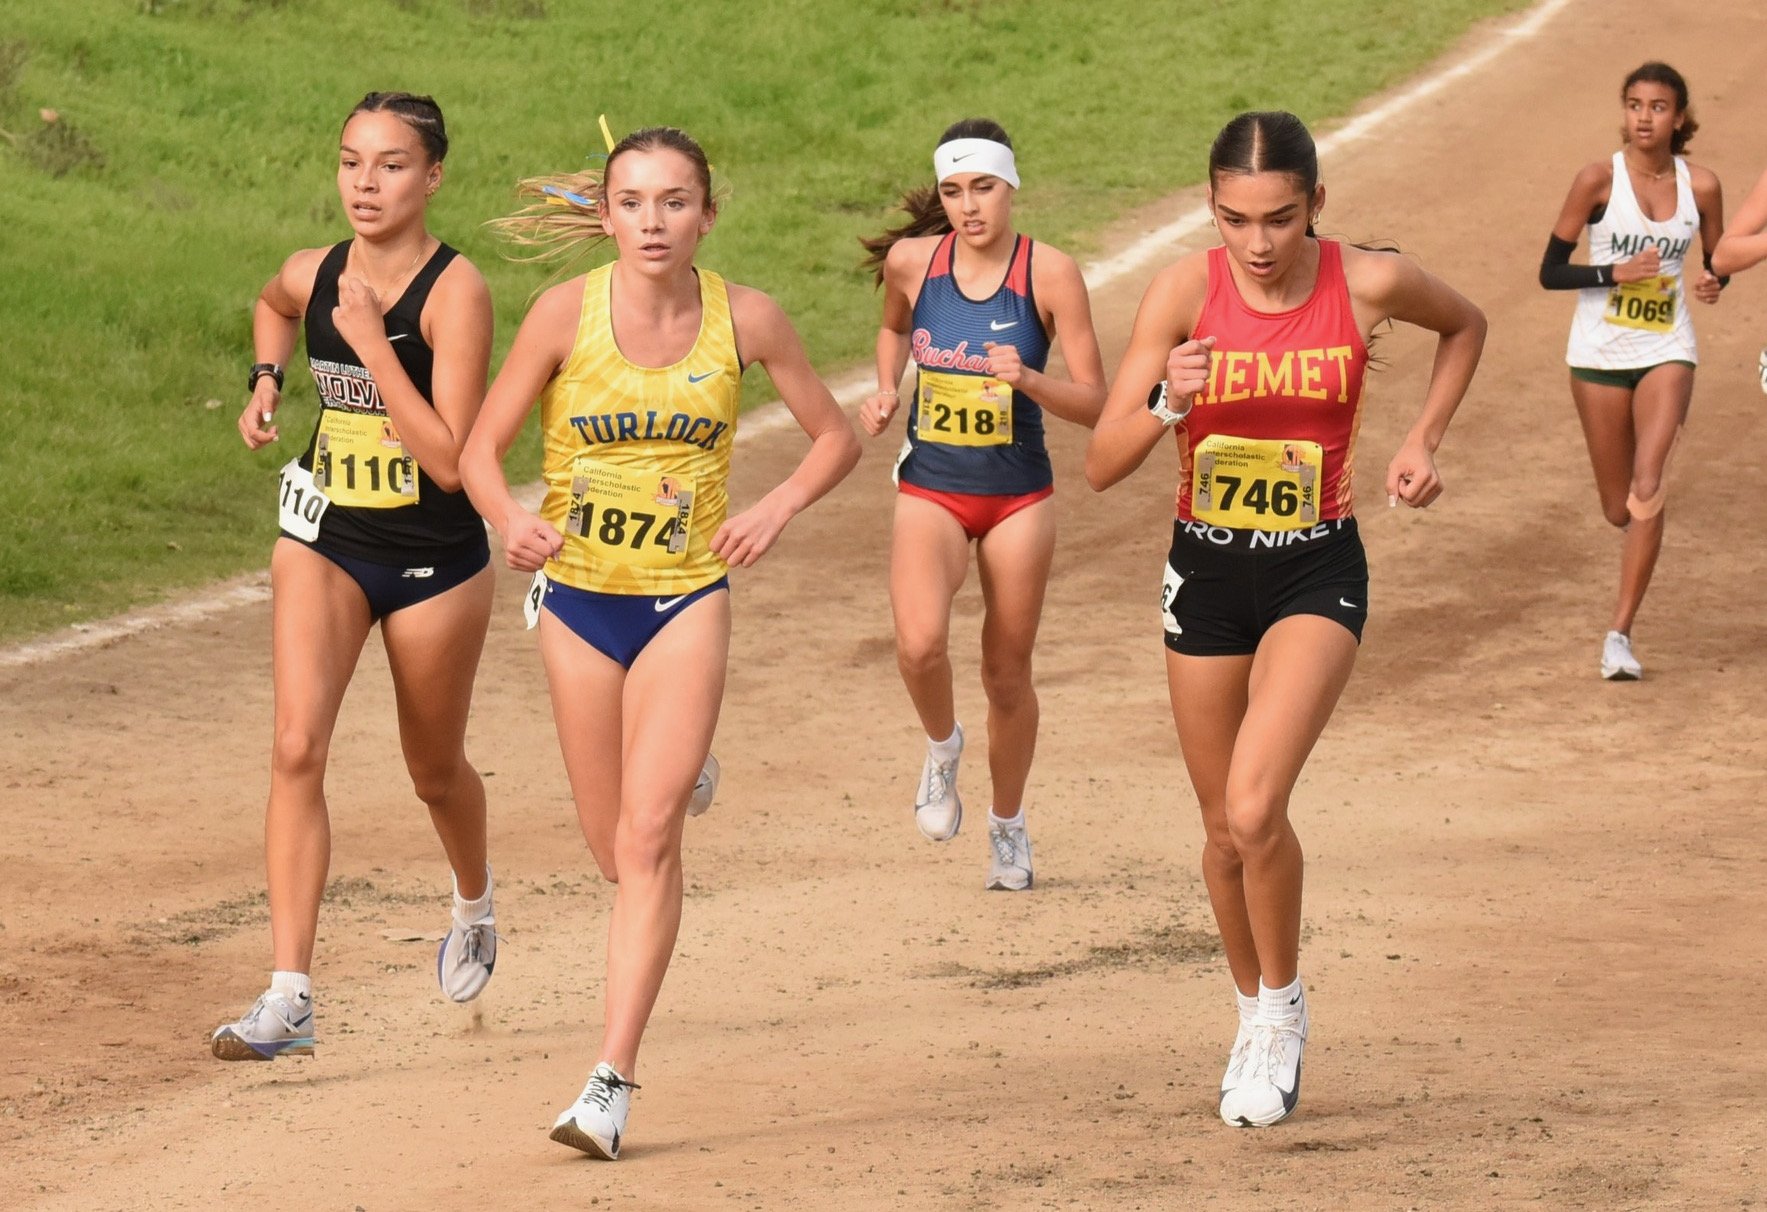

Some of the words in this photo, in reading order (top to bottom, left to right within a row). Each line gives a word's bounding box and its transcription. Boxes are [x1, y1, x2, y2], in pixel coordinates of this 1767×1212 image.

[1616, 295, 1674, 324] 1069
[340, 363, 374, 380] LUTHE
[314, 371, 387, 409] WOLV
[570, 410, 728, 451] TURLOCK
[933, 403, 995, 435] 218
[1206, 440, 1246, 452] California
[583, 466, 623, 481] California
[1214, 458, 1249, 468] deration
[587, 486, 624, 499] deration
[1199, 473, 1210, 496] 746
[1215, 475, 1299, 517] 746
[1302, 485, 1312, 508] 746
[569, 492, 581, 521] 1874
[677, 503, 690, 535] 1874
[579, 502, 679, 555] 1874
[1177, 517, 1234, 546] RO
[1249, 522, 1330, 549] NIKE
